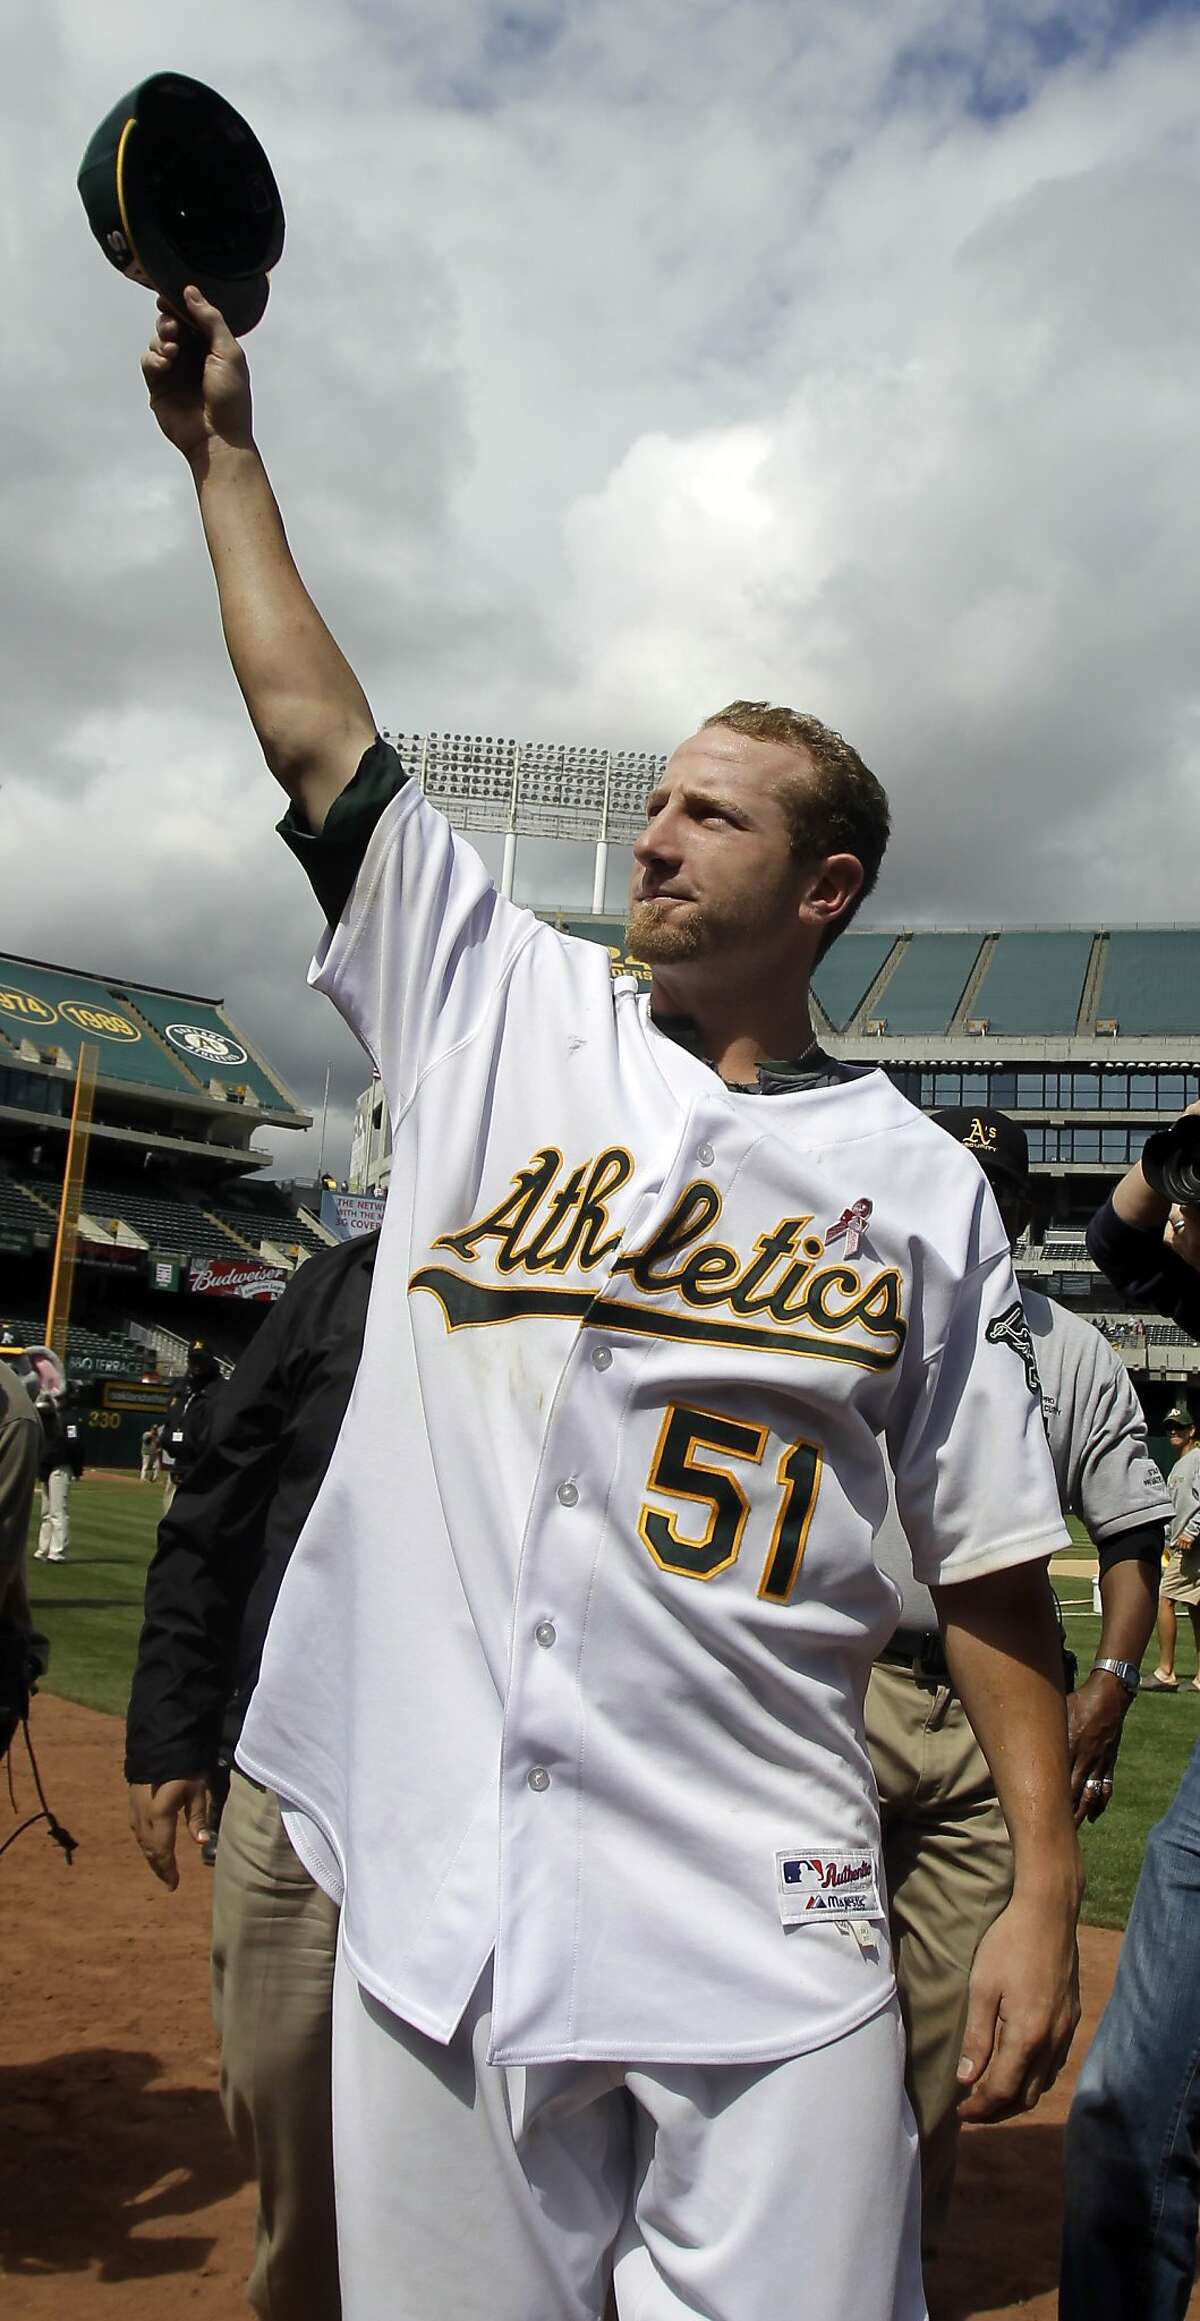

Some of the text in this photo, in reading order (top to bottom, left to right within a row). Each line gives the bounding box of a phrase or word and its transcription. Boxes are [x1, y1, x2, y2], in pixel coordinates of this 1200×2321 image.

[611, 968, 653, 981] DERS
[66, 1007, 134, 1037] 1989
[962, 1118, 998, 1146] A's
[336, 1208, 357, 1217] WITH
[338, 1199, 385, 1211] THE NETW
[335, 1217, 381, 1230] 3G COVER
[430, 1146, 905, 1337] Athletics
[189, 1266, 284, 1292] Budweiser
[95, 1359, 143, 1373] TERRACE
[88, 1411, 121, 1429] 330
[637, 1400, 823, 1604] 51
[821, 1860, 873, 1889] Authentic
